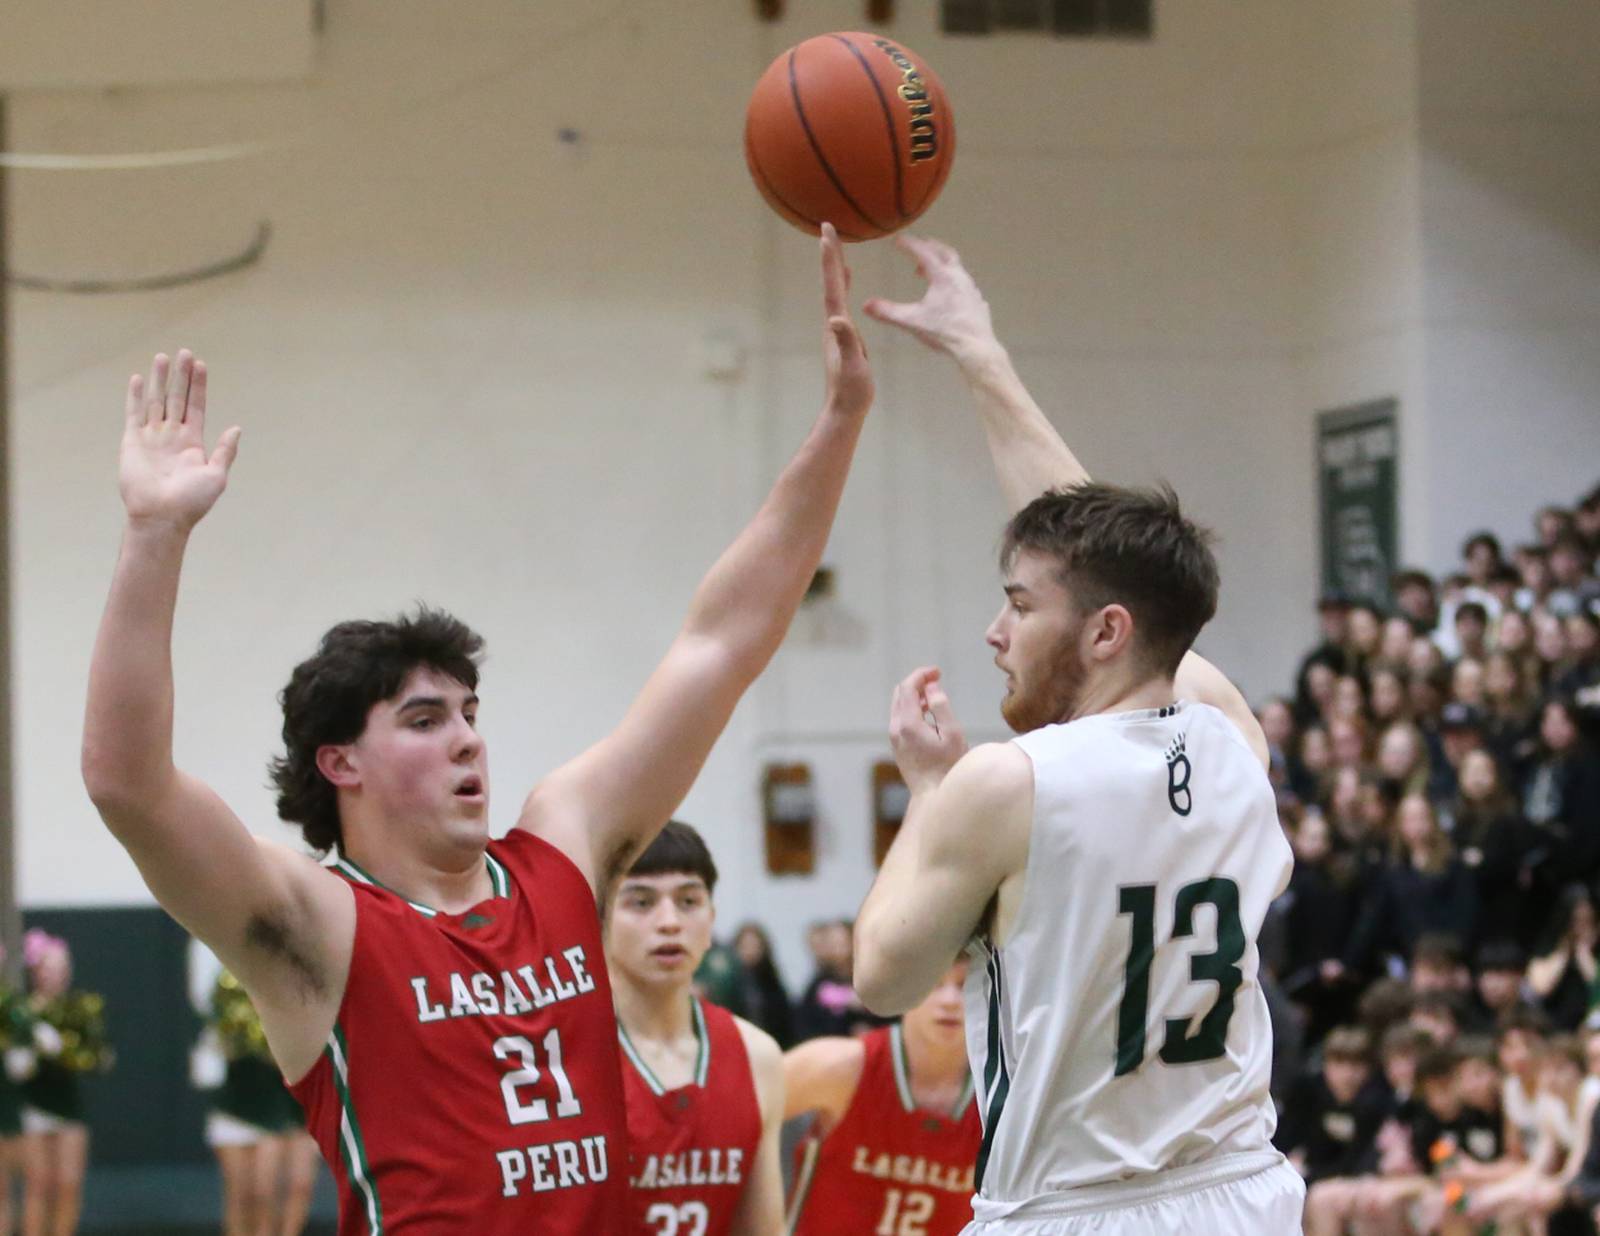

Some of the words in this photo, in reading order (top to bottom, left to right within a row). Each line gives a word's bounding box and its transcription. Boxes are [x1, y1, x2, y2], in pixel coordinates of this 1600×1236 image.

[410, 944, 595, 1023] LASALLE
[1110, 875, 1246, 1077] 13
[493, 1028, 582, 1125] 21
[496, 1135, 608, 1197] PERU
[874, 1188, 935, 1236] 12
